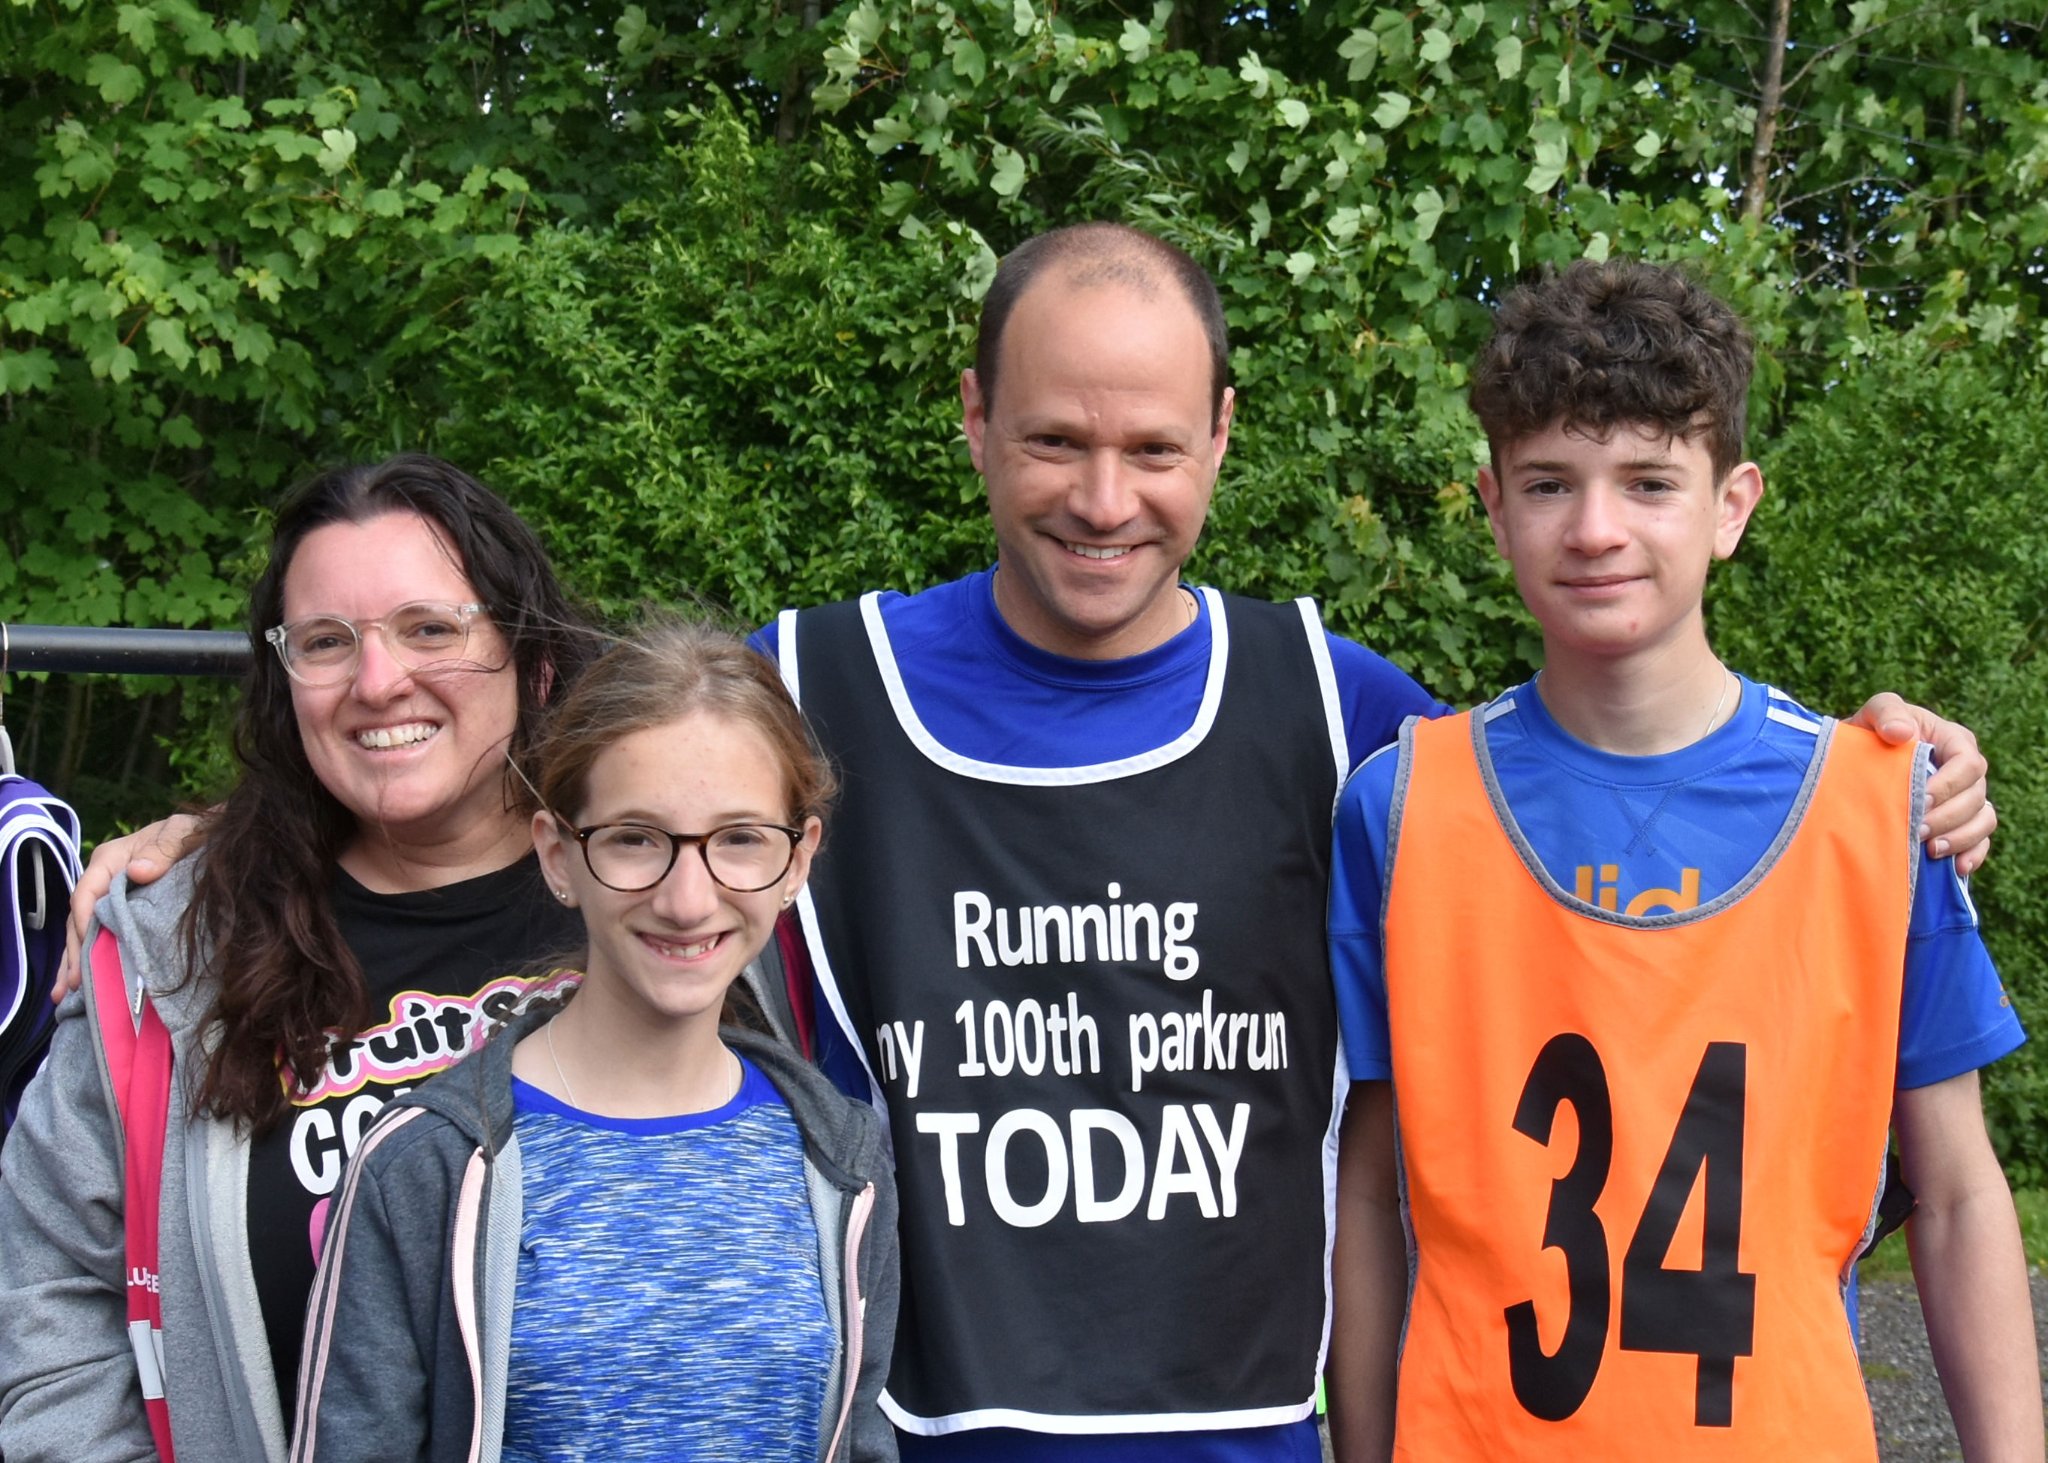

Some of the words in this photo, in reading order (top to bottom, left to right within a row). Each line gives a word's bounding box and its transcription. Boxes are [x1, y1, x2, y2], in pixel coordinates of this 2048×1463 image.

[953, 881, 1199, 981] Running
[294, 998, 475, 1093] ruit
[955, 992, 1101, 1077] 100th
[1128, 988, 1288, 1092] parkrun
[915, 1102, 1251, 1228] TODAY
[1505, 1033, 1756, 1427] 34
